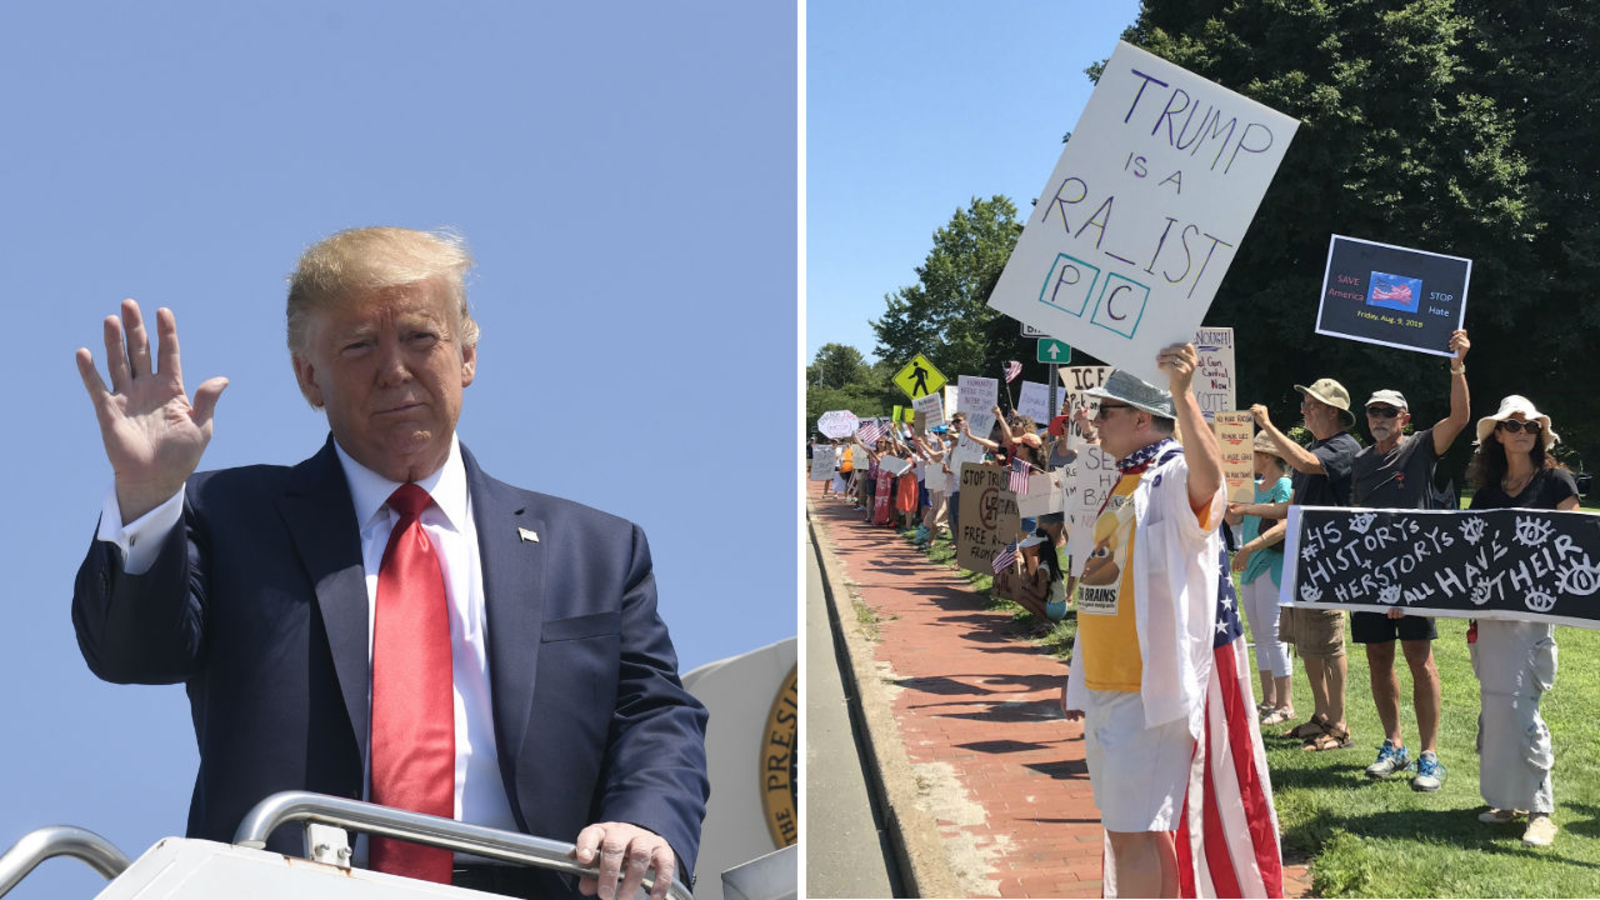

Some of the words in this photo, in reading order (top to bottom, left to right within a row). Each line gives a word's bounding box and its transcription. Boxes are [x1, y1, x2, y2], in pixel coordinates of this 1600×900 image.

[1124, 68, 1273, 175] TRUMP
[1124, 152, 1148, 178] IS
[1158, 170, 1182, 194] A
[1338, 275, 1360, 286] SAVE
[1051, 264, 1081, 302] P
[1107, 285, 1132, 321] C
[1329, 288, 1365, 301] America
[1430, 291, 1453, 303] STOP
[1428, 306, 1450, 317] Hate
[1405, 319, 1424, 329] 2019
[963, 470, 986, 486] STOP
[964, 526, 986, 545] FREE
[1403, 582, 1435, 605] ALL
[1490, 534, 1583, 600] THEIR
[1085, 587, 1116, 602] BRAINS
